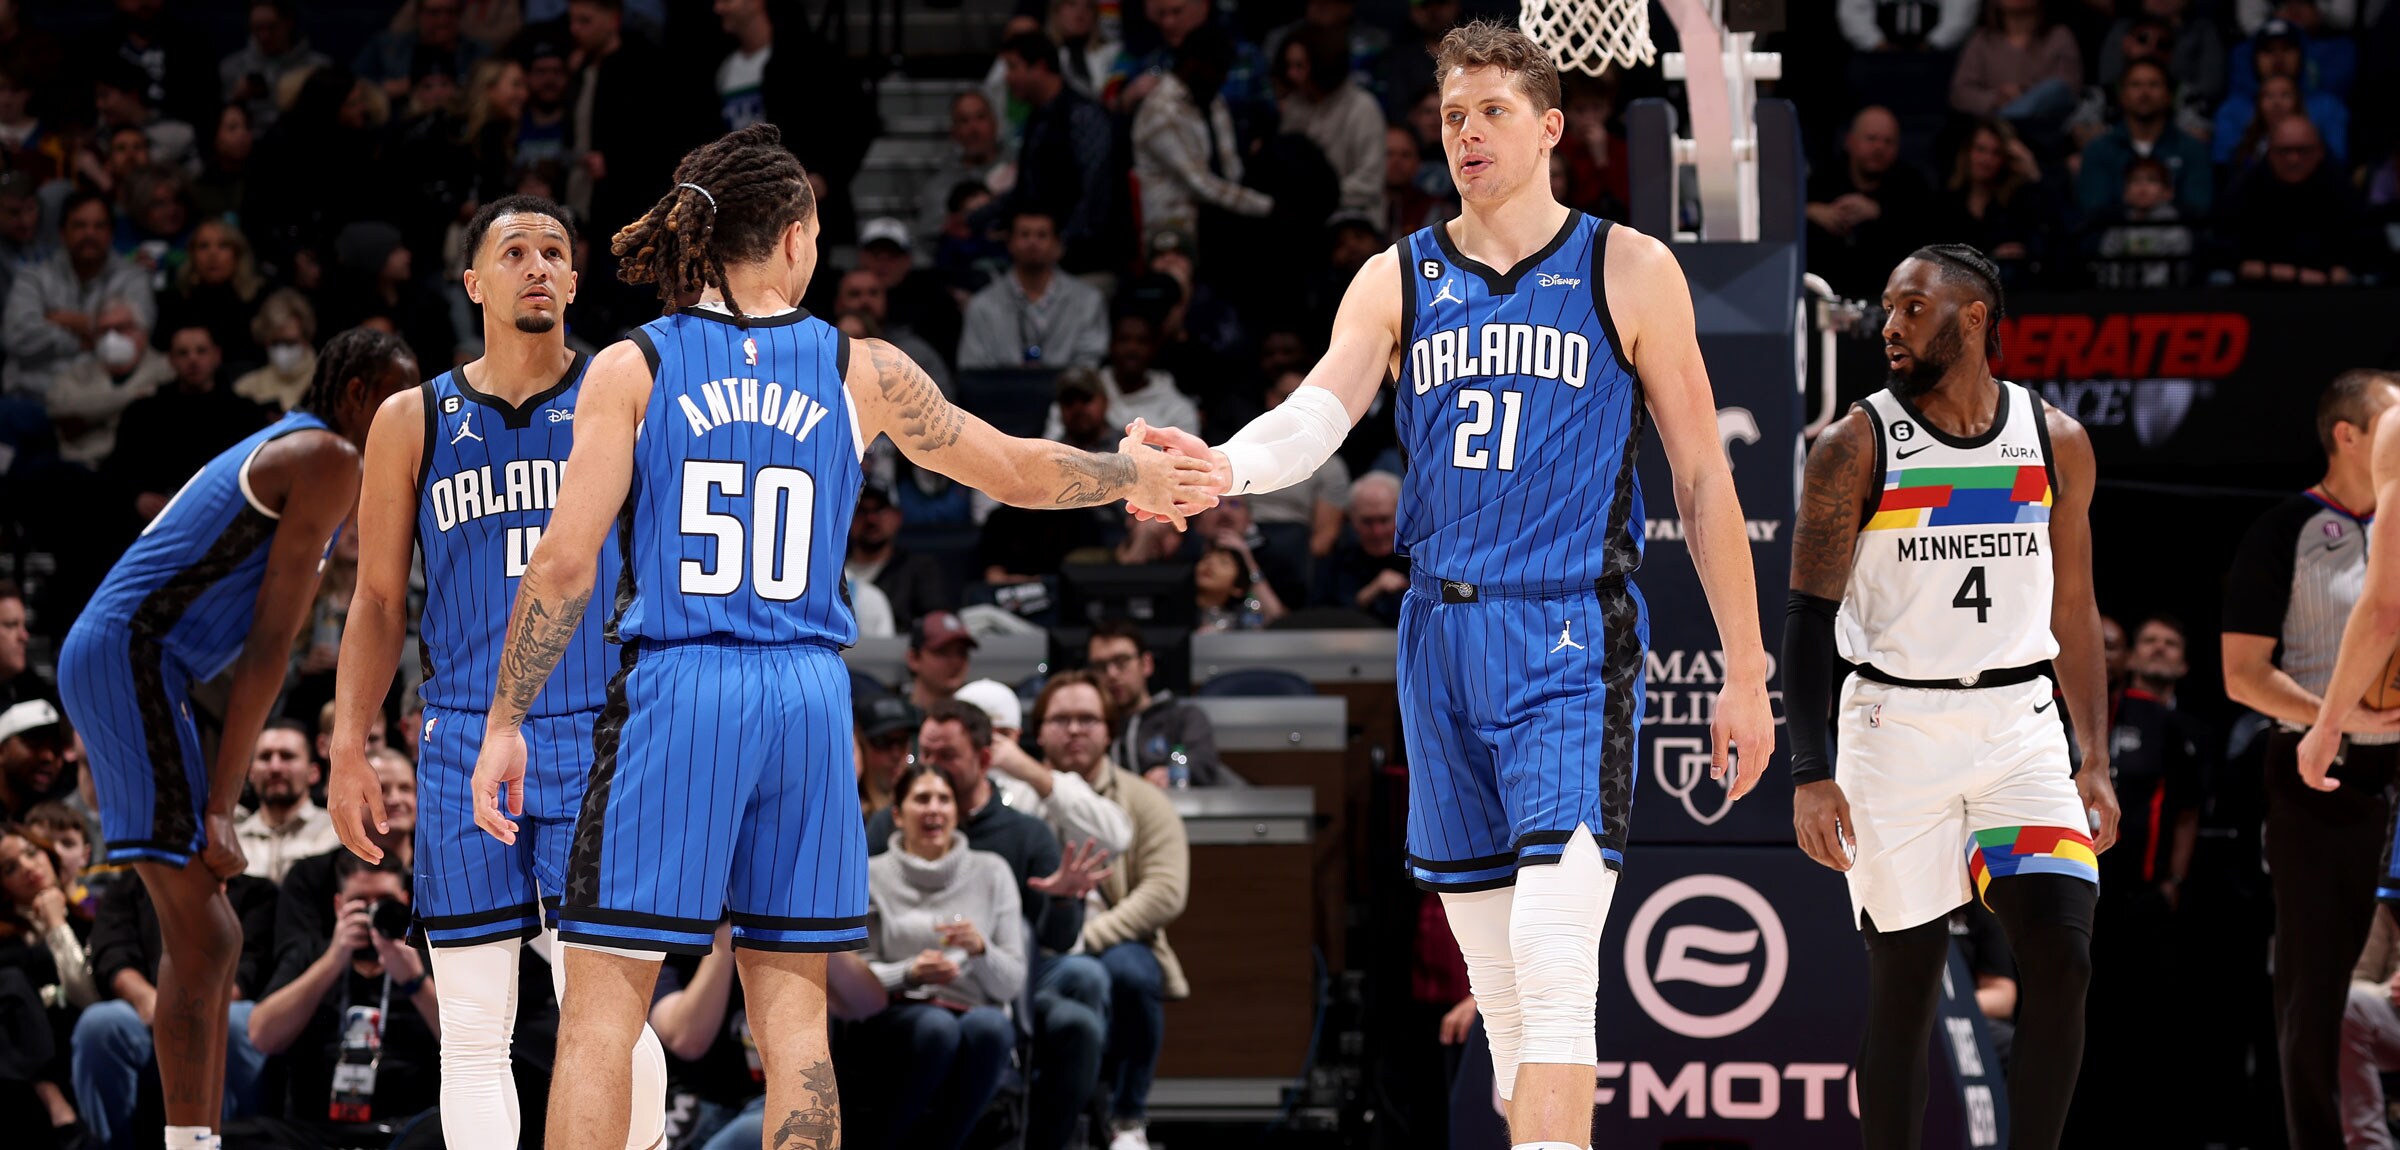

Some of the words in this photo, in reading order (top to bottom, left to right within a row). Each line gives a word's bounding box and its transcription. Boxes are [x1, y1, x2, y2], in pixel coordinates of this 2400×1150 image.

[1424, 261, 1439, 279] 6
[1411, 323, 1590, 397] ORLANDO
[444, 397, 459, 413] 6
[677, 377, 829, 443] ANTHONY
[1453, 389, 1524, 472] 21
[1893, 423, 1910, 440] 6
[431, 459, 568, 533] ORLAN
[679, 459, 816, 604] 50
[1898, 532, 2040, 562] MINNESOTA
[1952, 566, 1993, 623] 4
